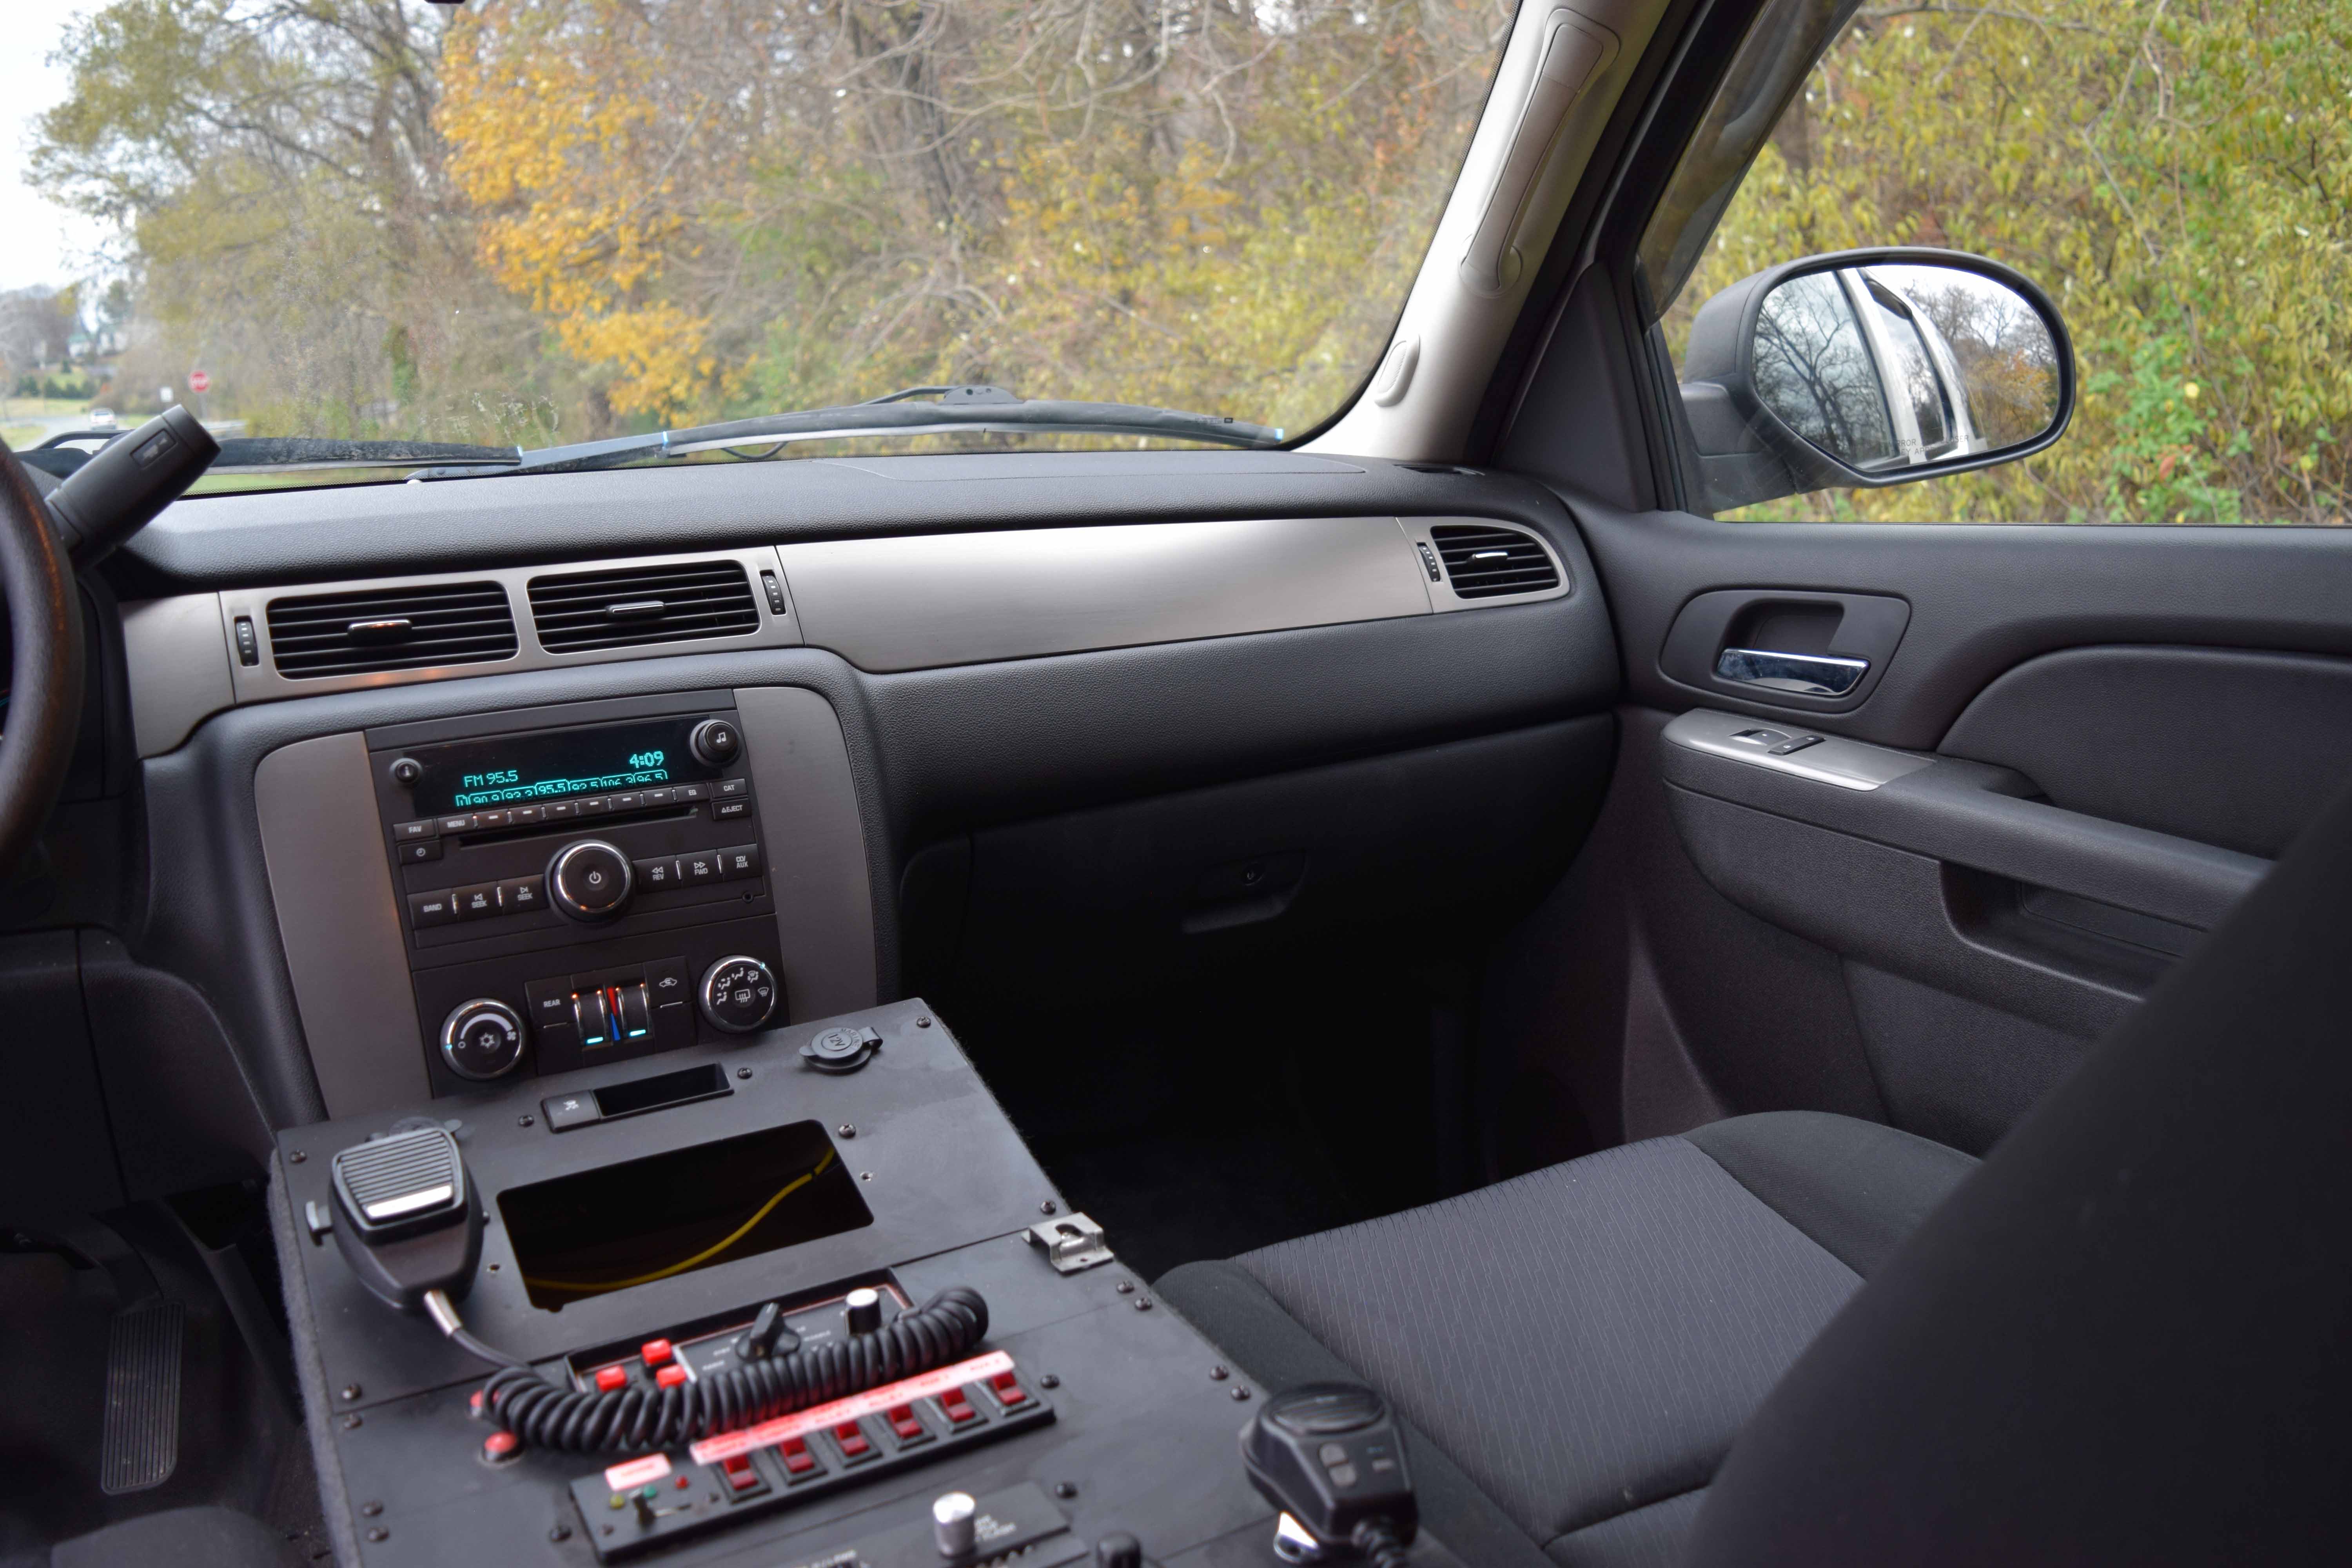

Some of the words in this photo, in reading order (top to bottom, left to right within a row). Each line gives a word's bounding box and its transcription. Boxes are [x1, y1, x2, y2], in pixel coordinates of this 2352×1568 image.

[630, 751, 664, 768] 4:09
[464, 775, 484, 787] FM
[486, 770, 518, 784] 95.5
[538, 783, 566, 794] 95.5
[447, 820, 466, 828] MENU
[408, 826, 422, 834] FAV
[517, 893, 533, 901] SEEK
[423, 903, 443, 913] BAND
[472, 900, 487, 909] SEEK
[543, 999, 561, 1008] REAR
